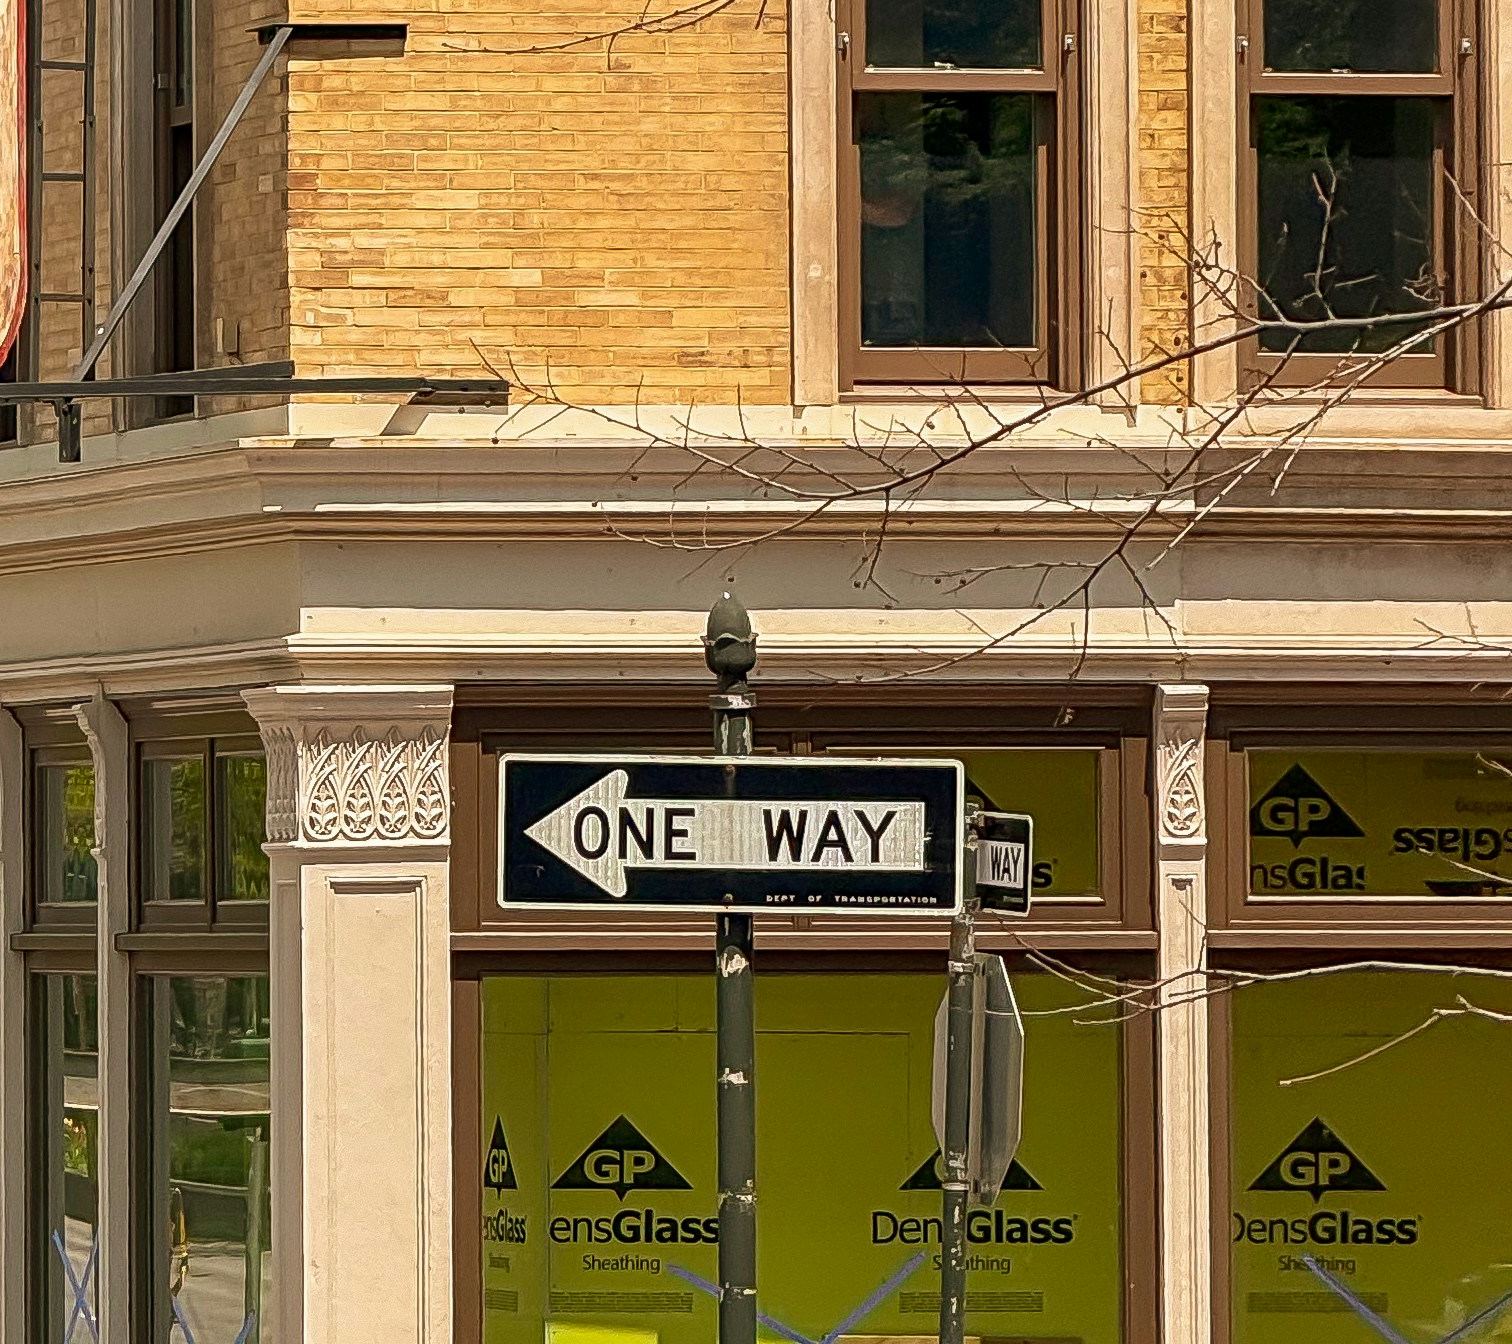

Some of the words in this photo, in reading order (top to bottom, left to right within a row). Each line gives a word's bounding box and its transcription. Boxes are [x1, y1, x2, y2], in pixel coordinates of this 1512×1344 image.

[1259, 797, 1331, 831] GP
[574, 805, 697, 862] ONE
[762, 808, 898, 864] WAY
[990, 845, 1022, 882] WAY
[834, 895, 938, 903] TRANSPORTATION
[489, 1149, 508, 1183] GP
[584, 1149, 656, 1184] GP
[1280, 1151, 1352, 1185] GP
[872, 1210, 1074, 1244] DenGlass
[582, 1254, 661, 1274] Sheathing
[933, 1254, 1011, 1274] Sthing
[1278, 1254, 1357, 1274] Shething
